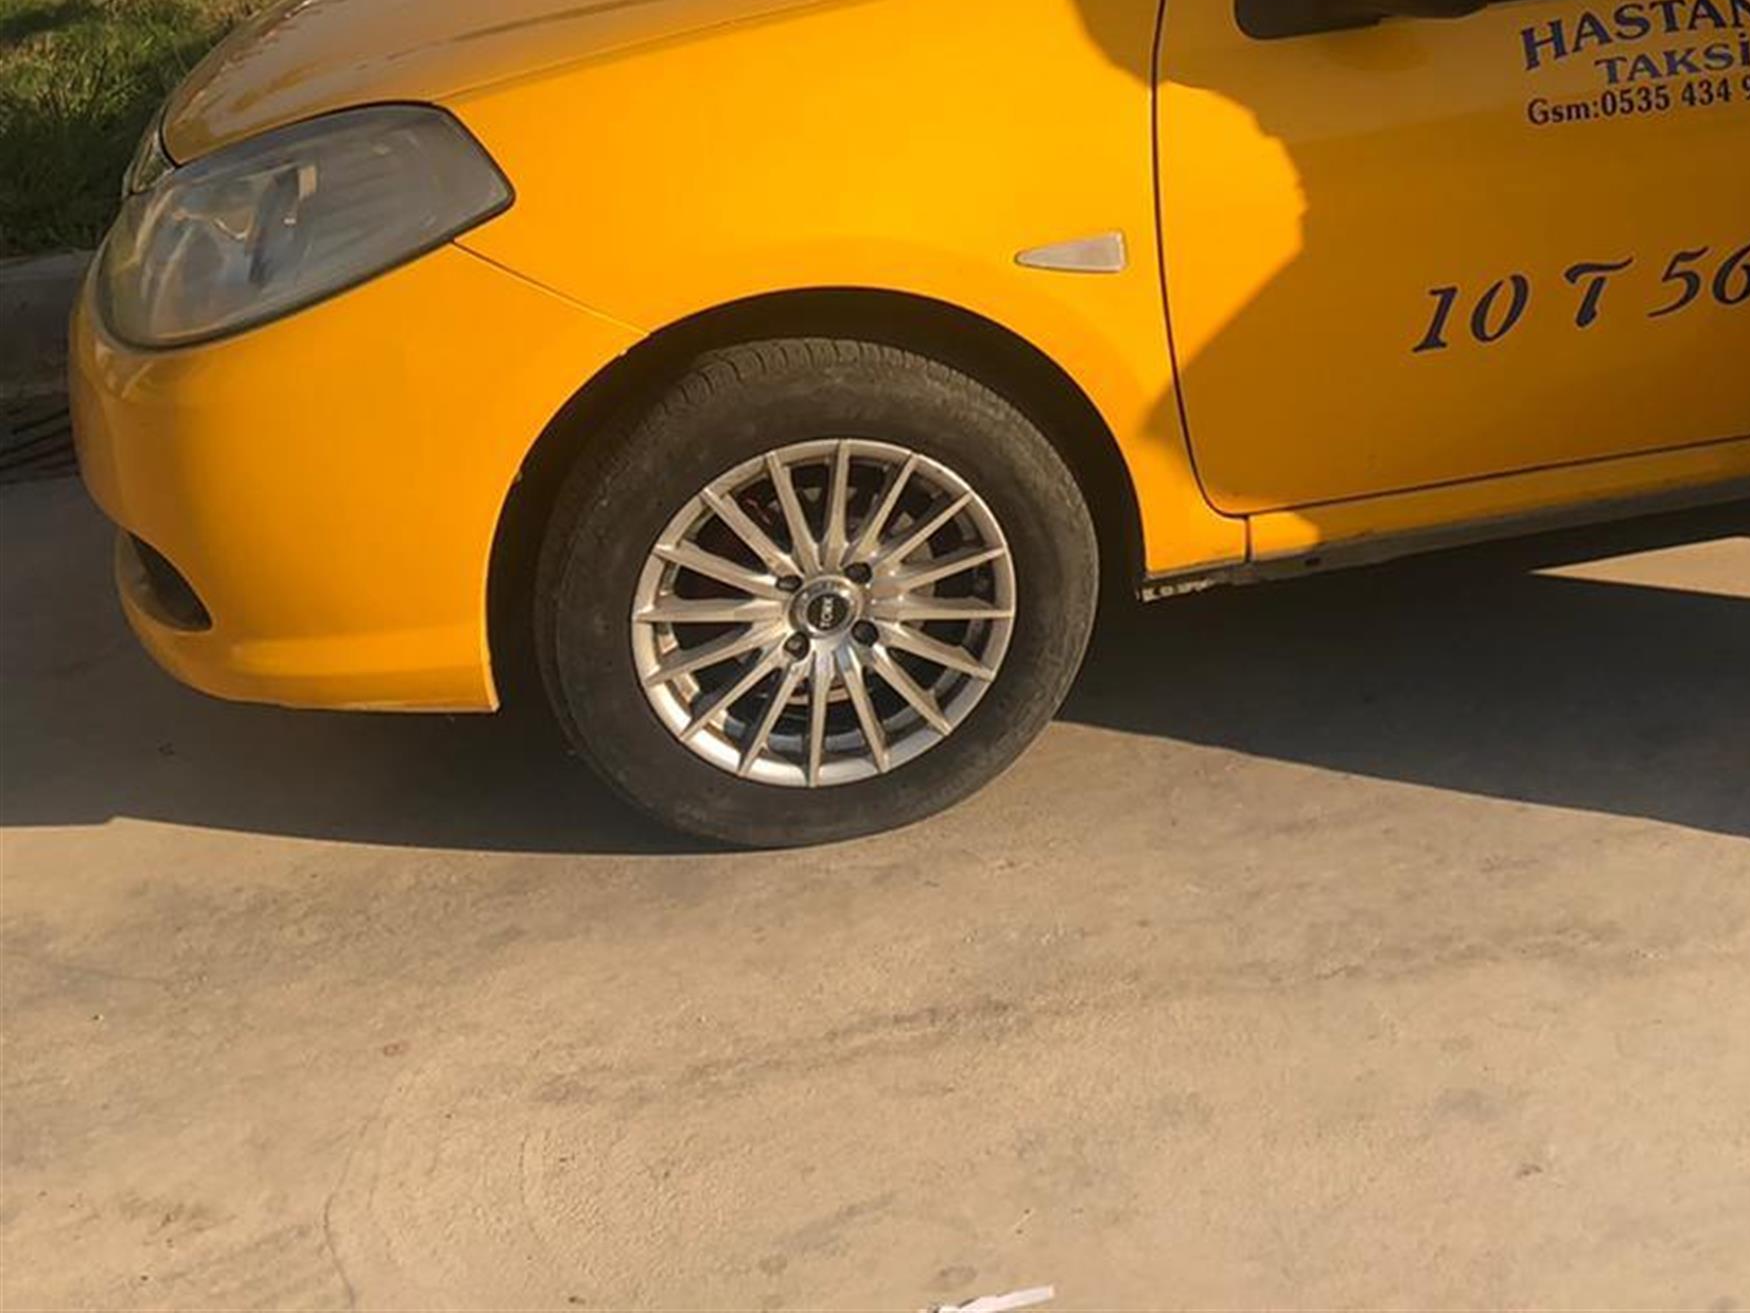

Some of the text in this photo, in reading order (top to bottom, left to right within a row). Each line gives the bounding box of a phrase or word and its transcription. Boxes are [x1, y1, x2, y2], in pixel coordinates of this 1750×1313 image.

[1528, 86, 1671, 125] Gsm:0535
[1682, 78, 1732, 108] 434
[1413, 274, 1530, 354] 10
[1564, 257, 1633, 327] T
